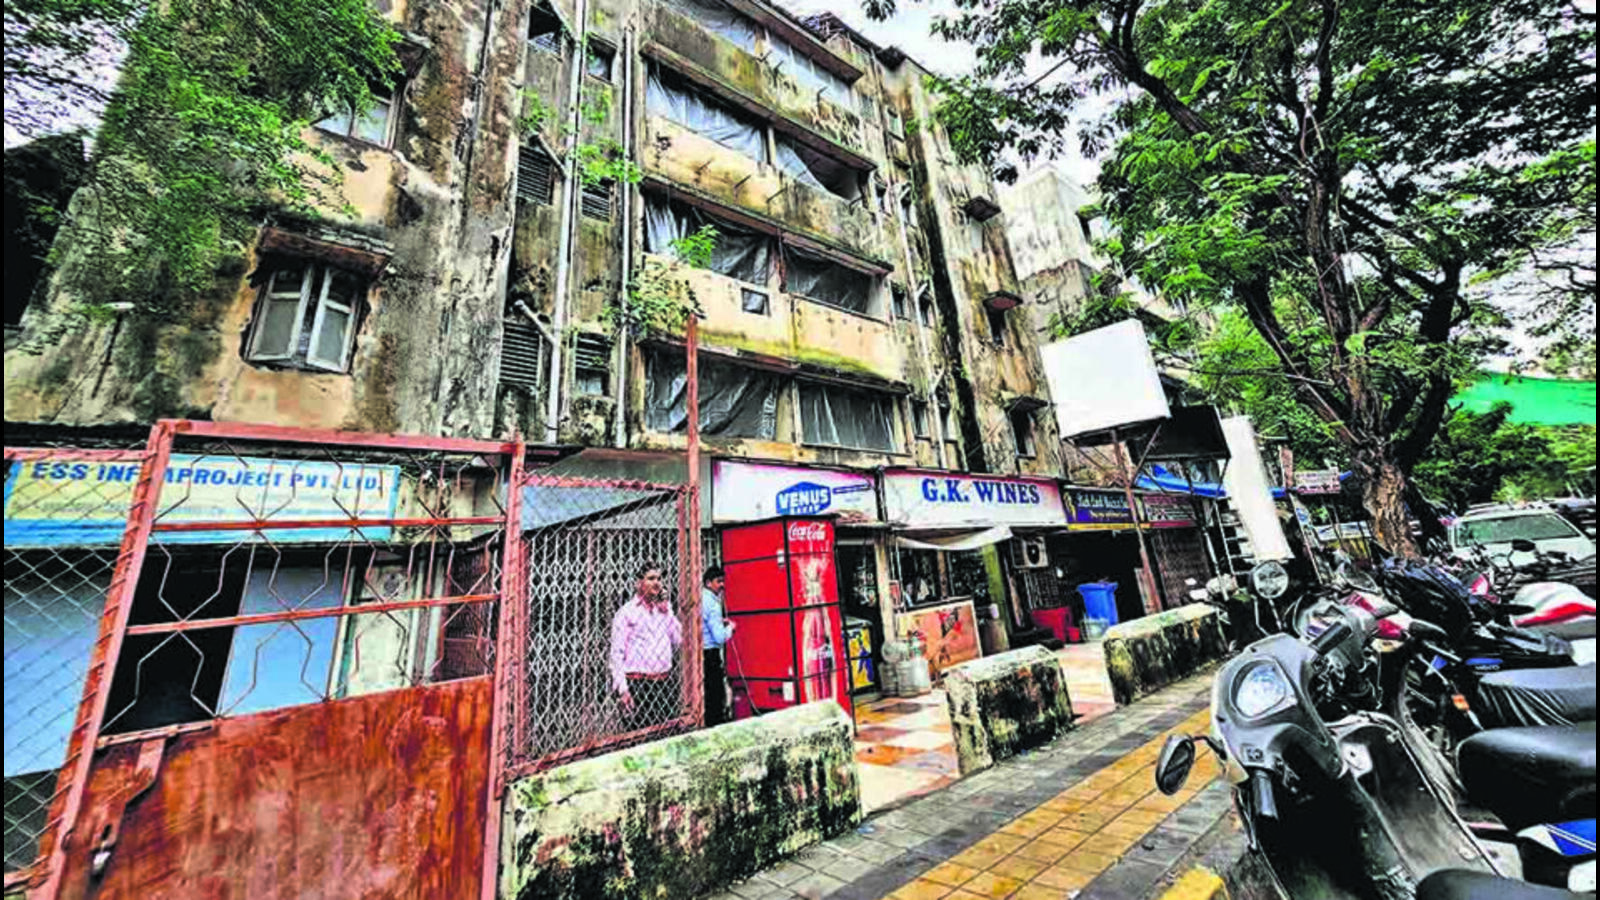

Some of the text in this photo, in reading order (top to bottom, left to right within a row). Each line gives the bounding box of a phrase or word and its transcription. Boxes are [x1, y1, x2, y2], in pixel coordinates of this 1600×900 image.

[32, 462, 89, 480] ESS
[97, 464, 284, 487] INFAPROJECT
[779, 489, 828, 509] VENUS
[922, 478, 1040, 504] G.K. WINES
